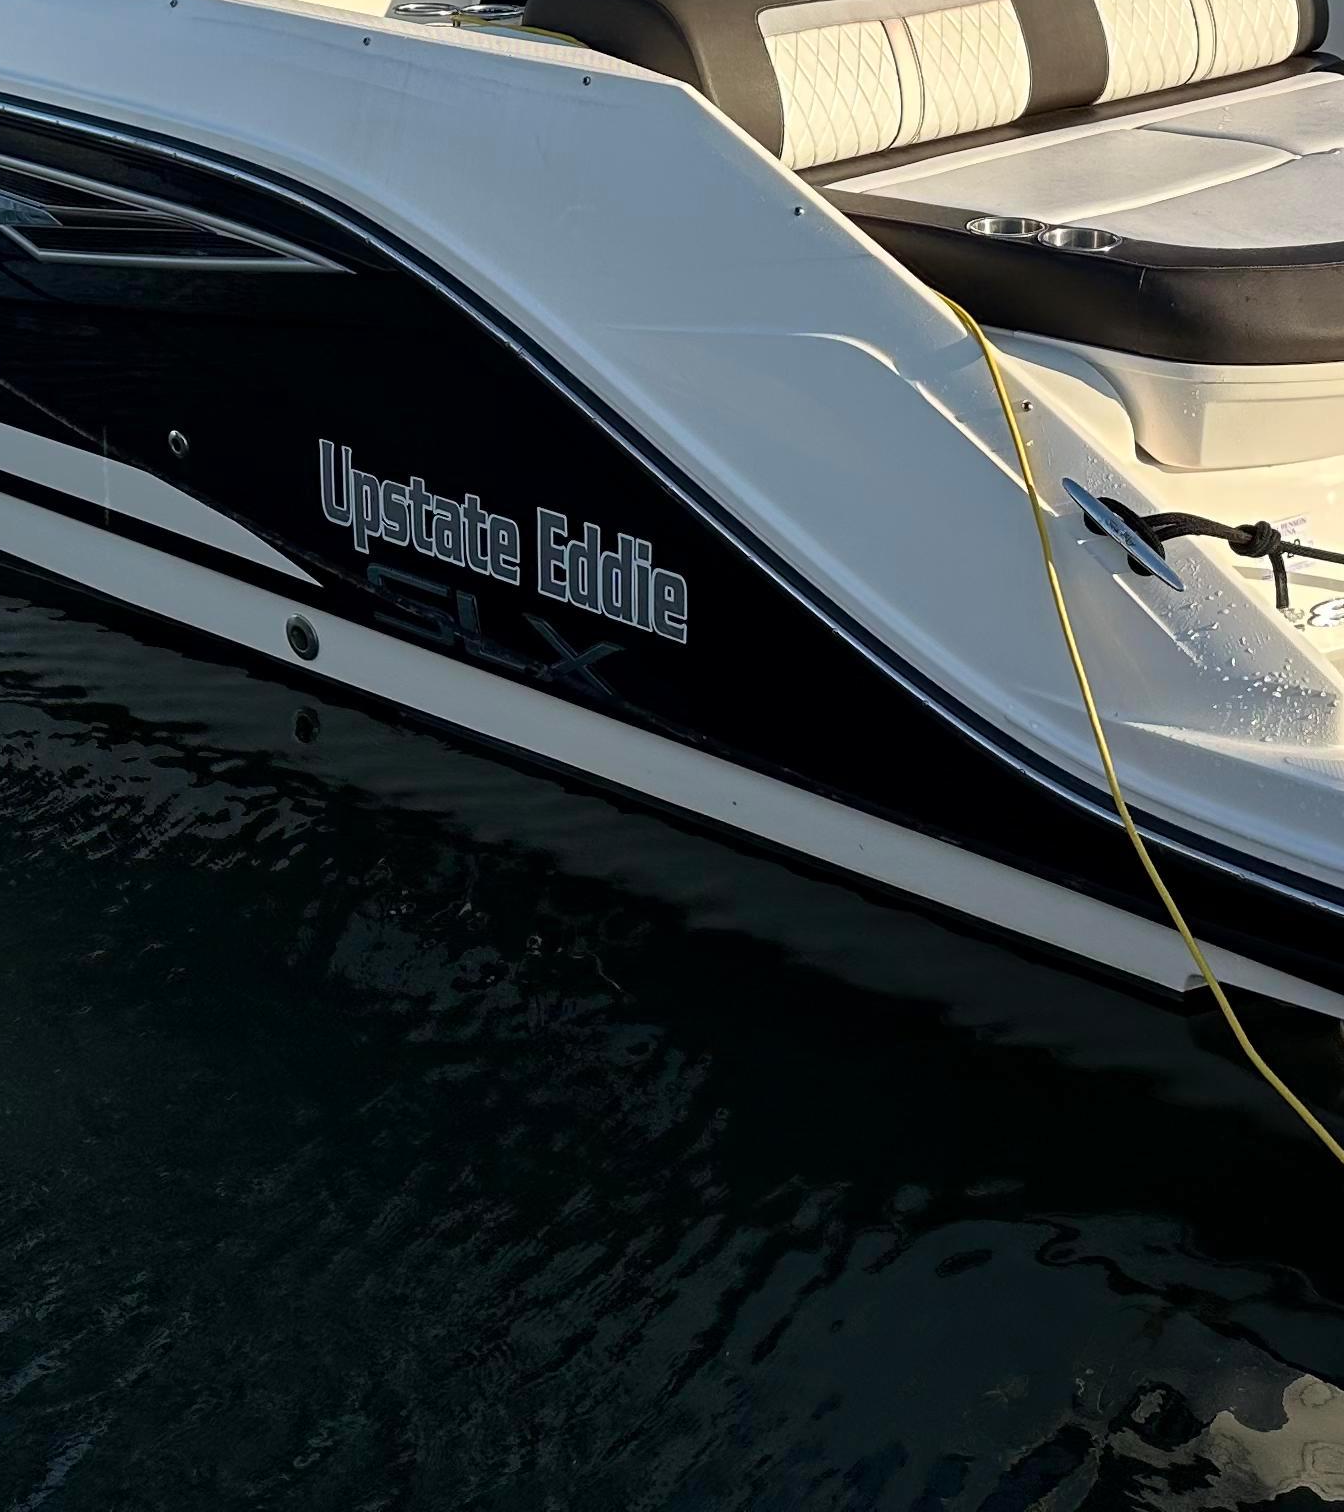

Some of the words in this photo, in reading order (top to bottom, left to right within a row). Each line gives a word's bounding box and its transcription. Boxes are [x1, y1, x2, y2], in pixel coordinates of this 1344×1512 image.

[319, 439, 520, 585] Upstate
[537, 507, 688, 644] Eddie
[367, 563, 627, 695] SLX
